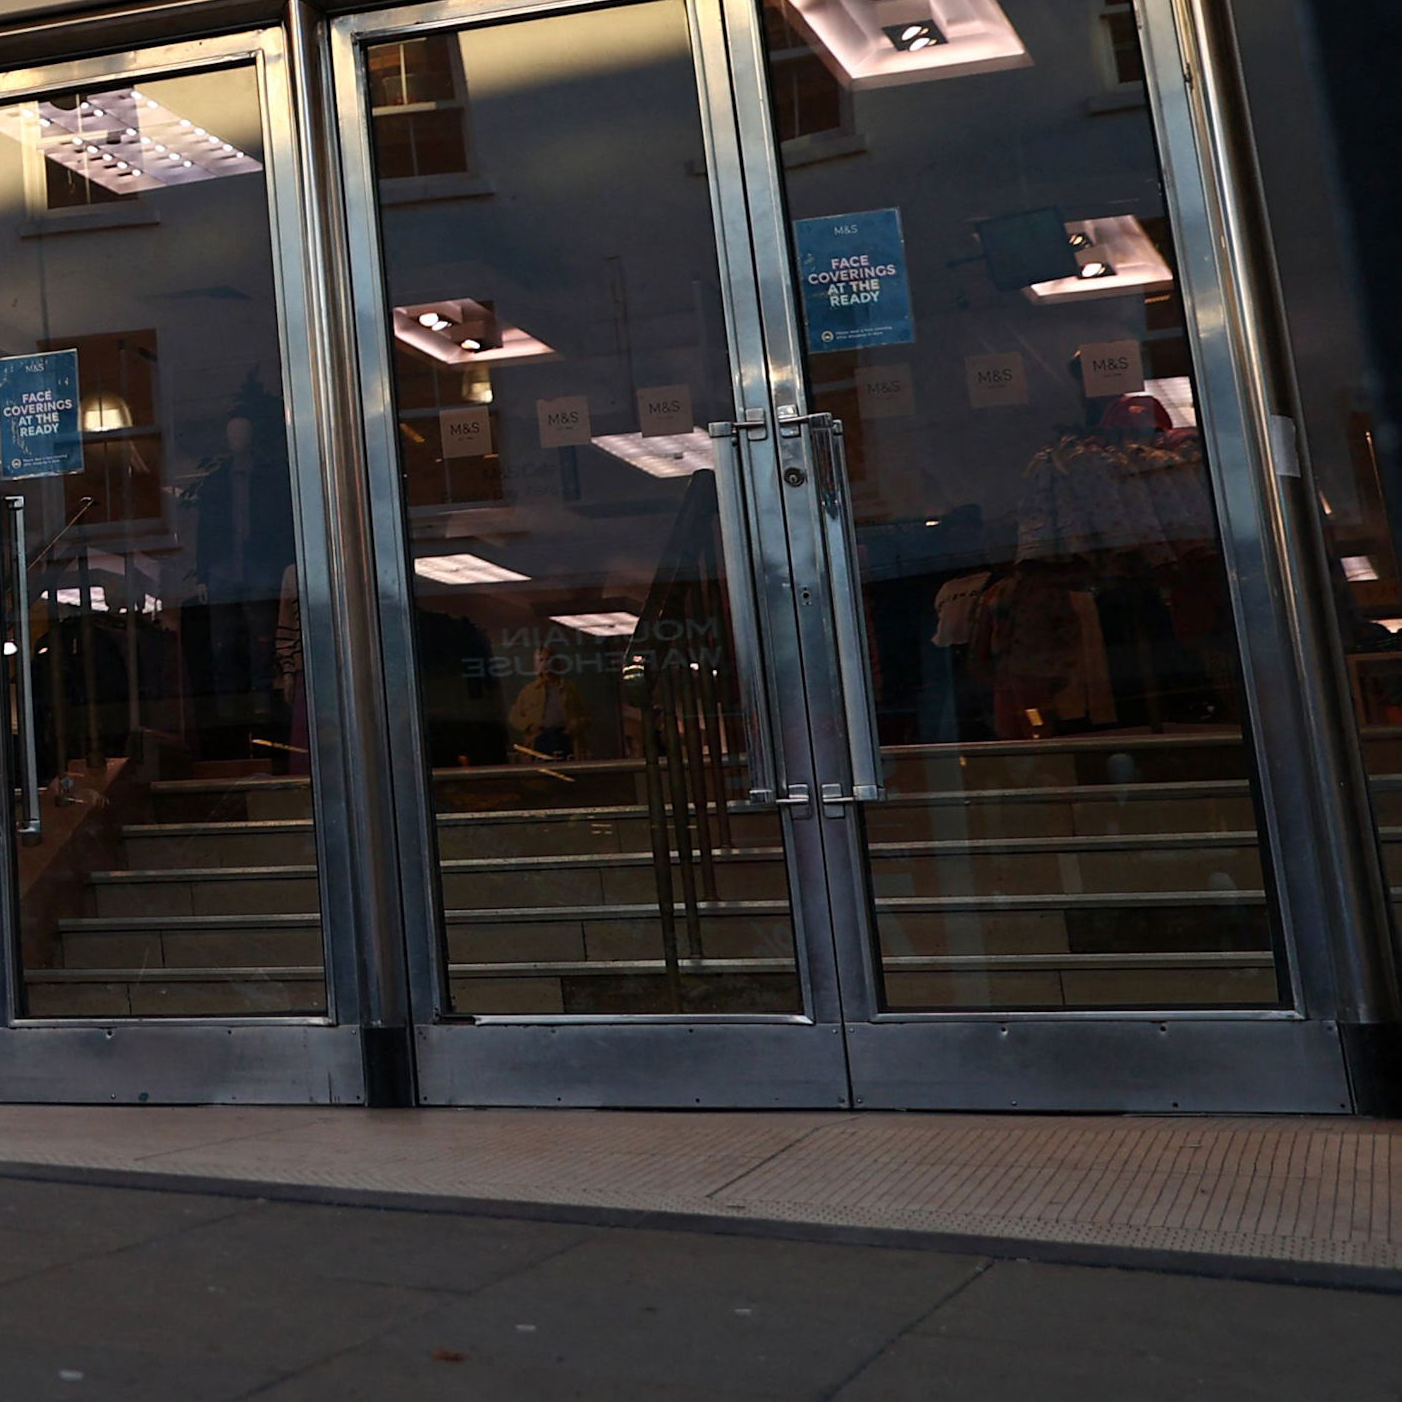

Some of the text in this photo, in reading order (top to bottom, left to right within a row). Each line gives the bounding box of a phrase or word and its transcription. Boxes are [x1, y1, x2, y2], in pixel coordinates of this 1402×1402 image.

[833, 224, 858, 236] M&S
[830, 254, 870, 270] FACE
[807, 263, 897, 285] COVERINGS
[827, 277, 881, 296] AT THE
[829, 290, 881, 308] READY
[25, 363, 45, 373] M&S
[1091, 356, 1130, 371] M&S
[977, 369, 1013, 384] M&S
[866, 380, 901, 394] M&S
[21, 390, 52, 403] FACE
[2, 398, 73, 417] COVERINGS
[648, 400, 681, 414] M&S
[18, 412, 60, 427] AT THE
[547, 411, 580, 426] M&S
[19, 424, 60, 437] READY
[450, 421, 480, 436] M&S
